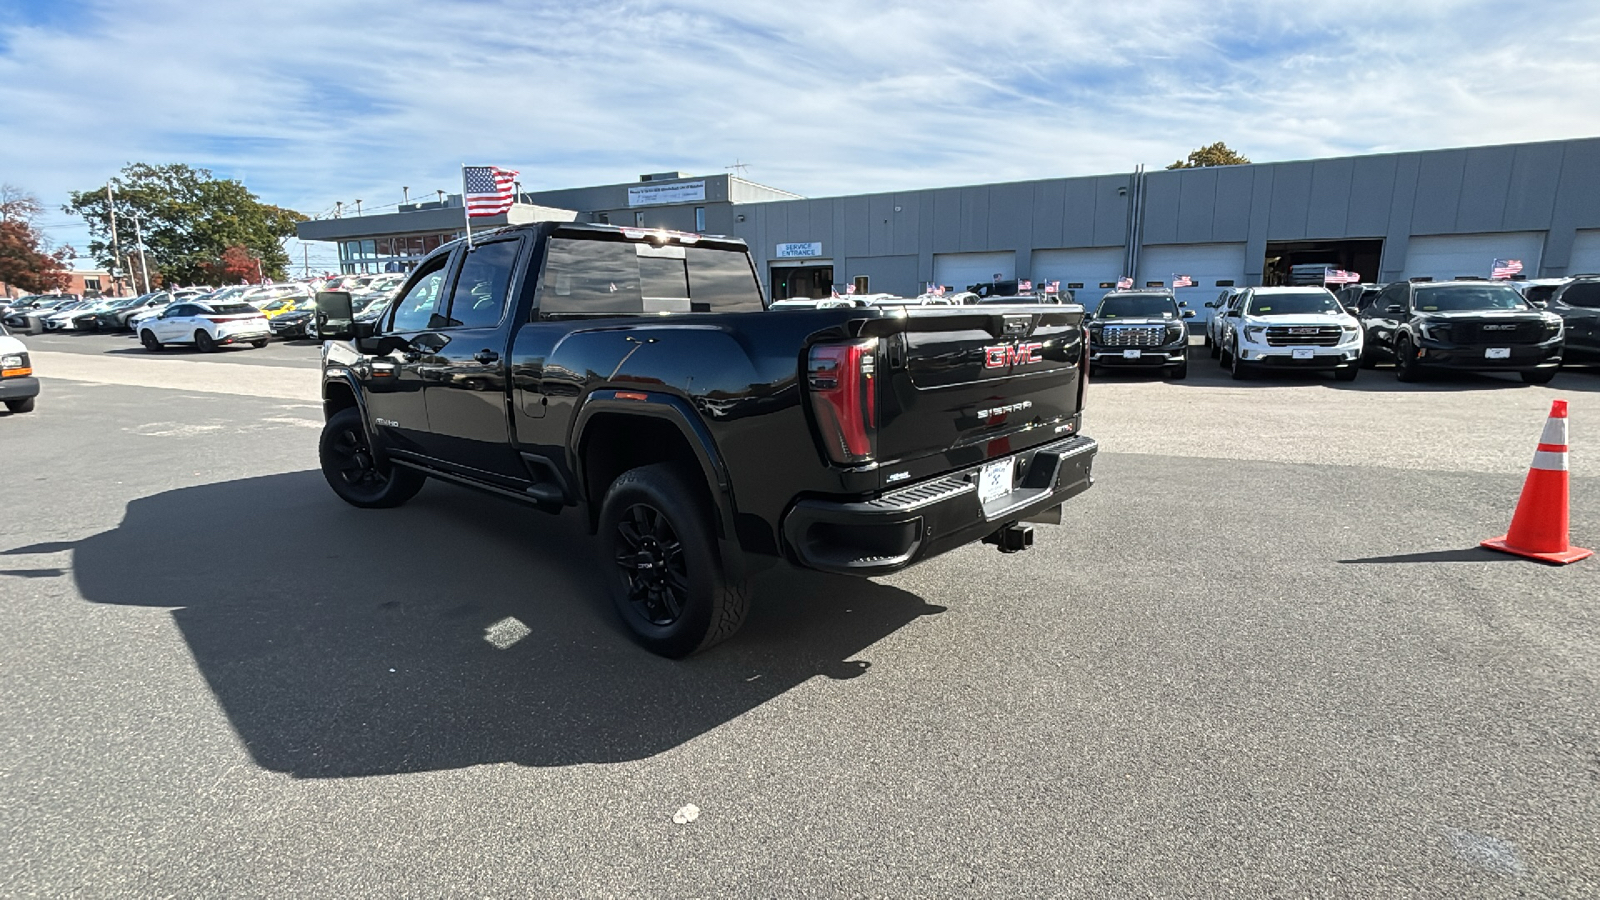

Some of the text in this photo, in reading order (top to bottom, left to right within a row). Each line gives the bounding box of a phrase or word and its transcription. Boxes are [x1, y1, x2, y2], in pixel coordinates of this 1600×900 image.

[782, 249, 815, 257] ENTRANCE
[785, 243, 812, 251] SERVICE
[984, 342, 1043, 369] GMC
[977, 400, 1032, 419] SIERRA
